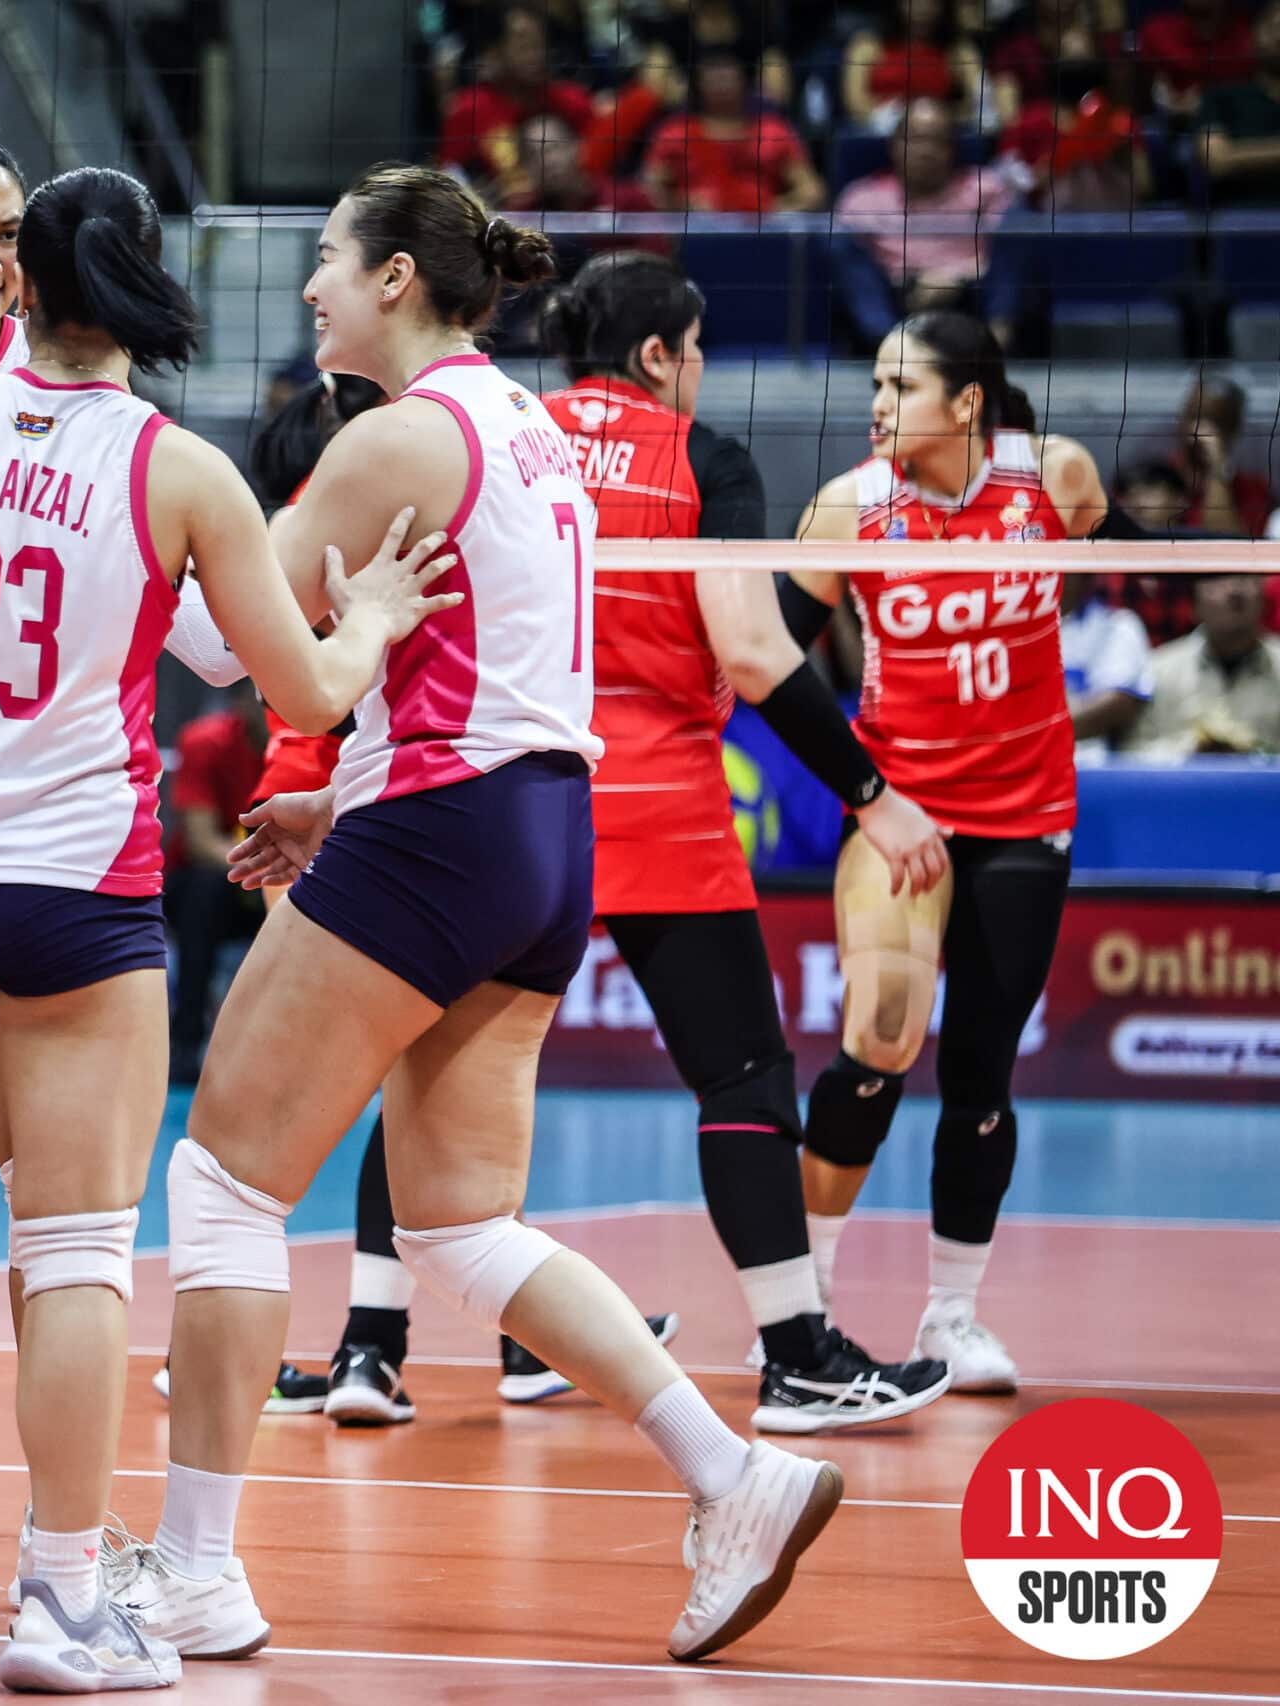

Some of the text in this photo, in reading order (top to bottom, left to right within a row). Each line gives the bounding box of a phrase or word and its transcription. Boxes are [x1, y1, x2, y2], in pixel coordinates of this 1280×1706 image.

[510, 428, 581, 488] GUMABA
[567, 433, 636, 484] ENG
[551, 503, 582, 673] 7
[877, 576, 1059, 639] Gazz
[947, 637, 1010, 706] 10
[1091, 930, 1280, 993] Onlin
